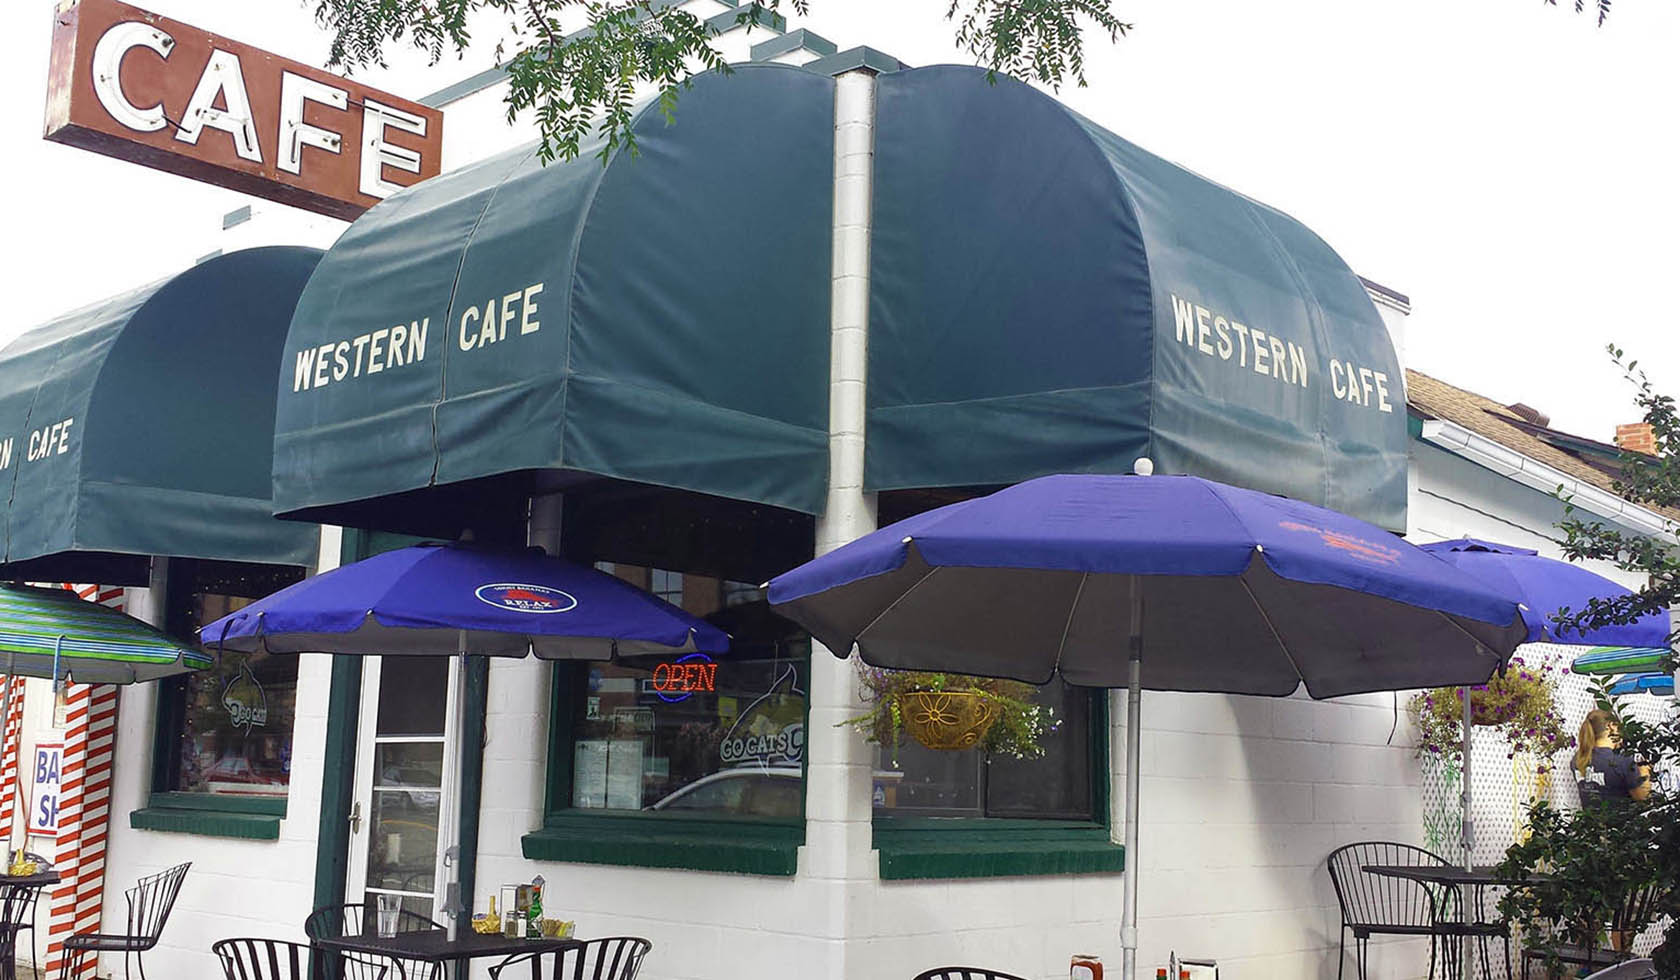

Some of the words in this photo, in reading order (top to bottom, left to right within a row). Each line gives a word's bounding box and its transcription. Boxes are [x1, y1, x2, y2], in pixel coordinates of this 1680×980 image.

[91, 21, 428, 200] CAFE
[293, 317, 430, 393] WESTERN
[458, 282, 545, 352] CAFE
[1171, 294, 1308, 388] WESTERN
[1329, 358, 1393, 413] CAFE
[27, 417, 74, 462] CAFE
[652, 663, 718, 692] OPEN
[722, 739, 745, 759] GO
[746, 731, 789, 756] CATS
